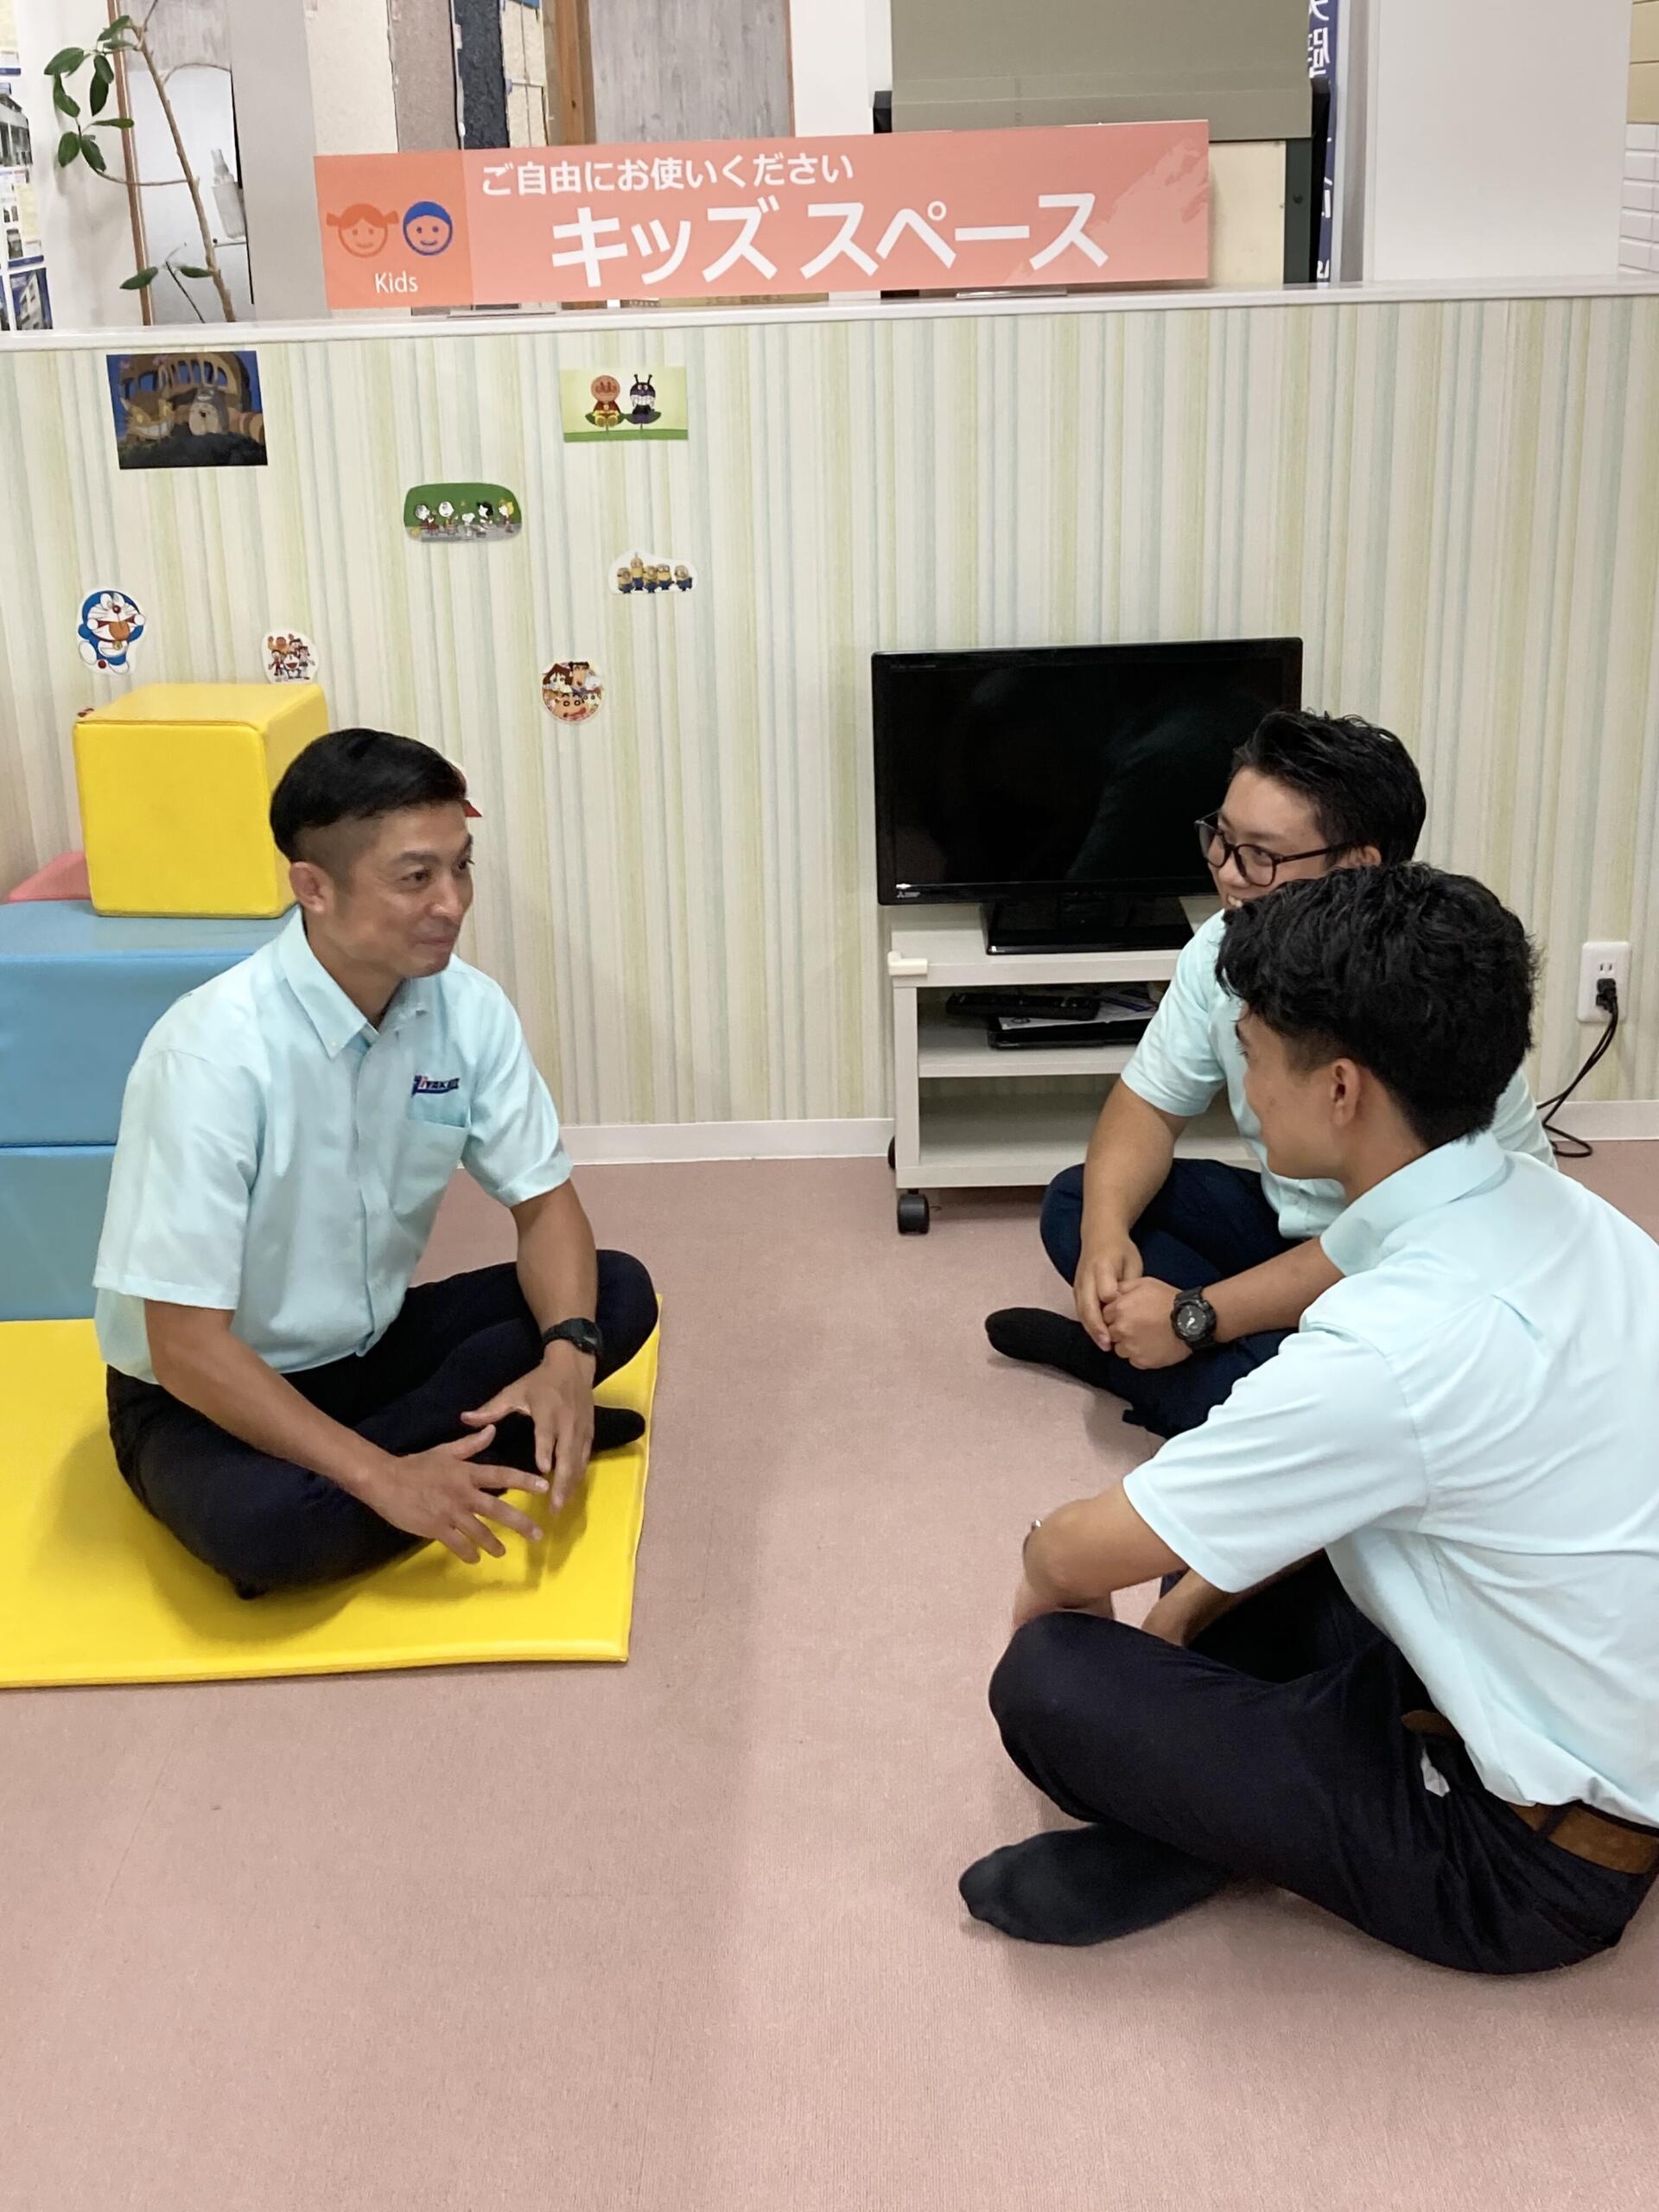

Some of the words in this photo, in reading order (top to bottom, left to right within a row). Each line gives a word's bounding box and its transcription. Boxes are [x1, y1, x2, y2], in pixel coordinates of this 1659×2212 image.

[481, 152, 854, 197] ご自由にお使いください
[374, 272, 418, 293] Kids
